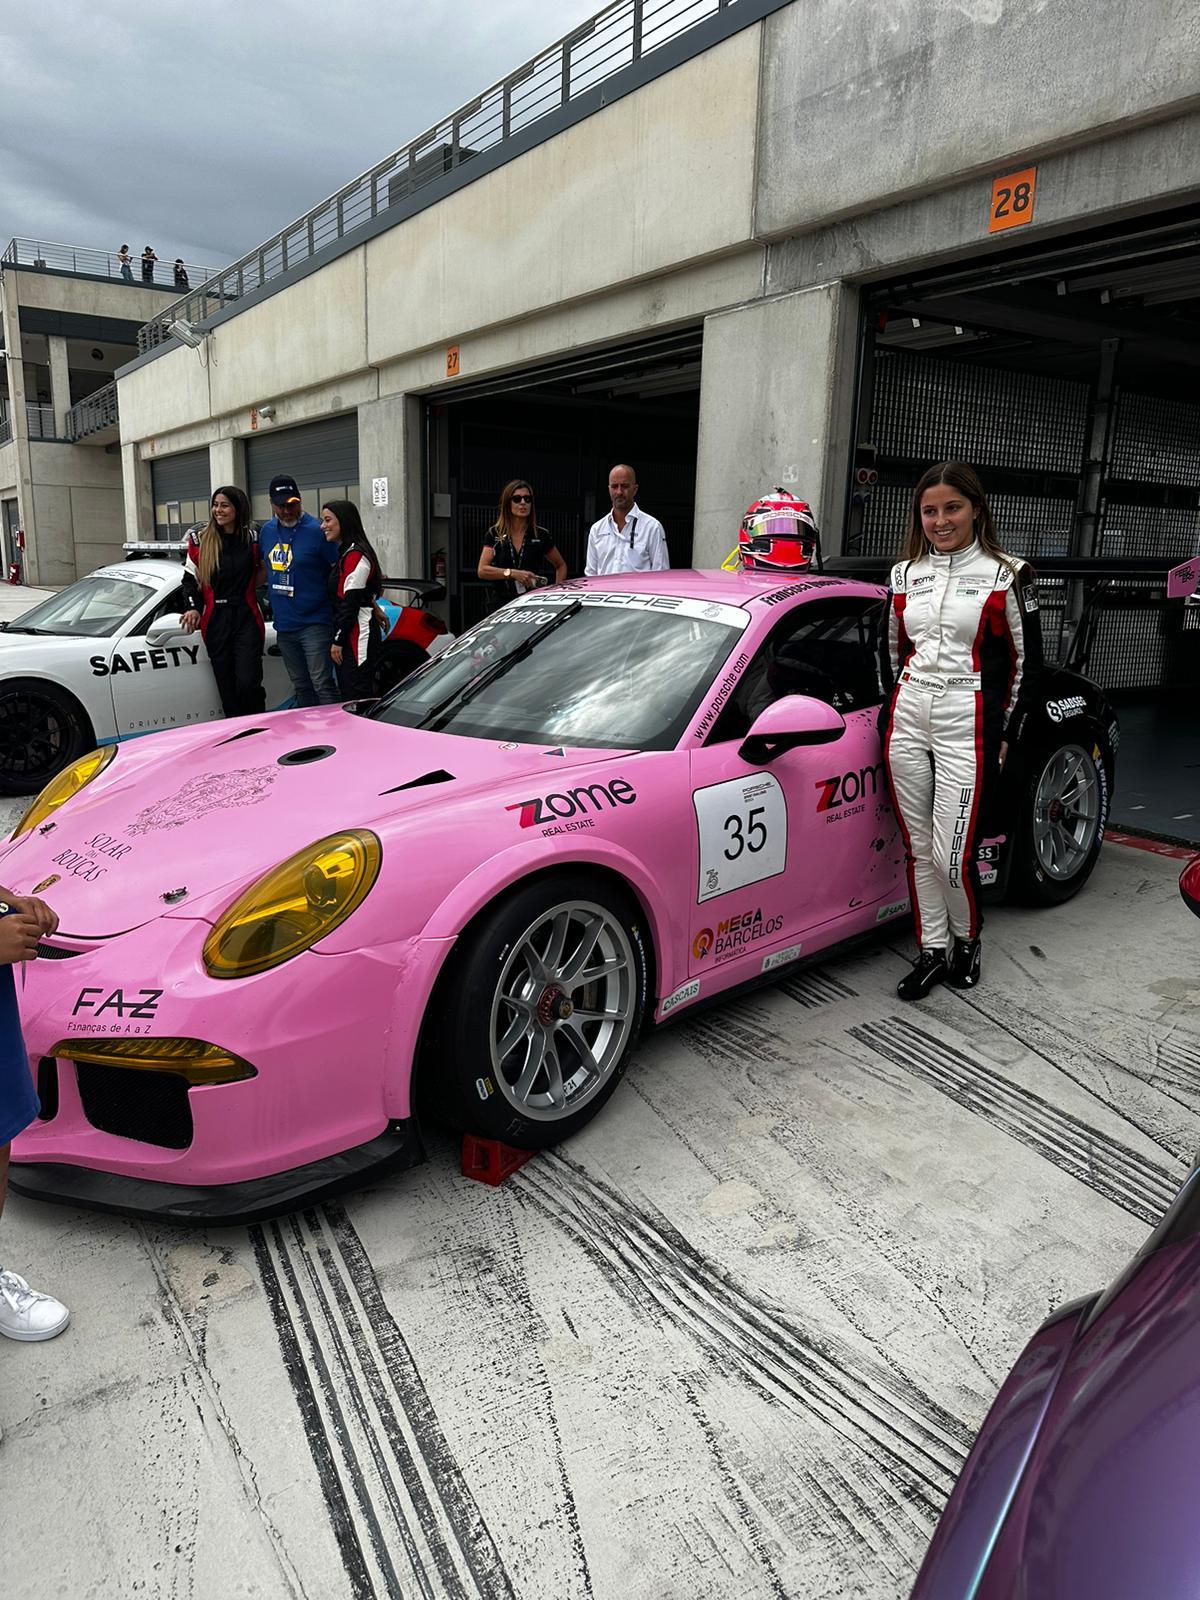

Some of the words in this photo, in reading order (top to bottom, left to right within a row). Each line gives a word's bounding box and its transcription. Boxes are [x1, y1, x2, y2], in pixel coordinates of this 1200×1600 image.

[995, 182, 1031, 218] 28
[447, 351, 458, 369] 27
[489, 607, 561, 626] Queiro
[524, 592, 683, 610] PORSCHE
[89, 644, 200, 677] SAFETY
[693, 652, 750, 740] www.porsche.com
[129, 716, 176, 730] DRIVEN
[186, 712, 199, 721] BY
[814, 761, 889, 814] zom
[504, 778, 637, 829] zome
[825, 812, 843, 825] REAL
[842, 803, 866, 819] ESTATE
[541, 826, 566, 838] REAL
[564, 818, 596, 833] ESTATE
[723, 806, 768, 861] 35
[948, 787, 973, 889] PORSCHE
[84, 832, 133, 861] SOLAR
[51, 848, 108, 882] BOUÇAS
[714, 914, 784, 955] BARCELOS
[716, 907, 763, 938] MEGA
[71, 987, 165, 1019] FAZ
[662, 982, 699, 1012] CASCAIS
[66, 1021, 107, 1033] Finanças
[110, 1023, 122, 1033] de
[124, 1024, 131, 1033] A
[134, 1026, 141, 1034] a
[144, 1025, 152, 1034] Z
